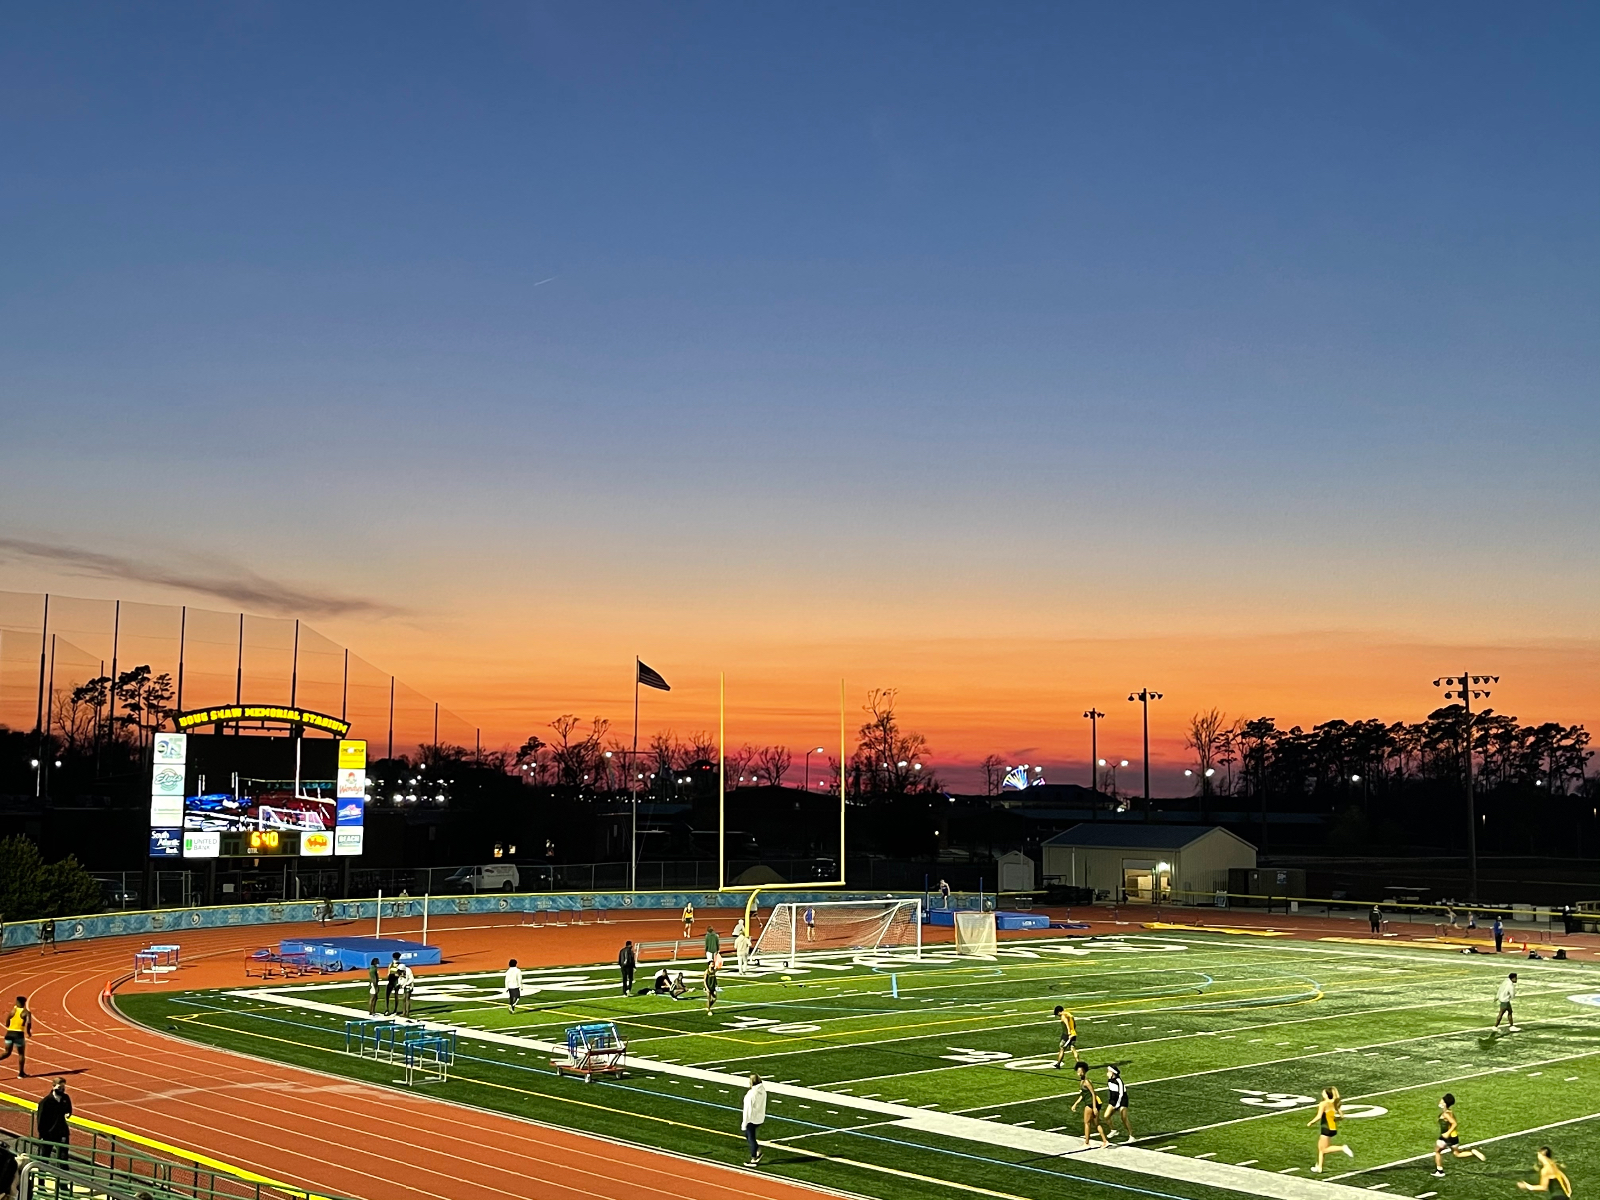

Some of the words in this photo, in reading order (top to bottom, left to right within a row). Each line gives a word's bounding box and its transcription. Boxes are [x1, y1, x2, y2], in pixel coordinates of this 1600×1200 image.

[178, 711, 209, 727] DOUG
[210, 707, 243, 721] SHAW
[244, 707, 301, 721] MEMORIAL
[302, 712, 349, 734] STADIUM
[151, 830, 170, 839] South
